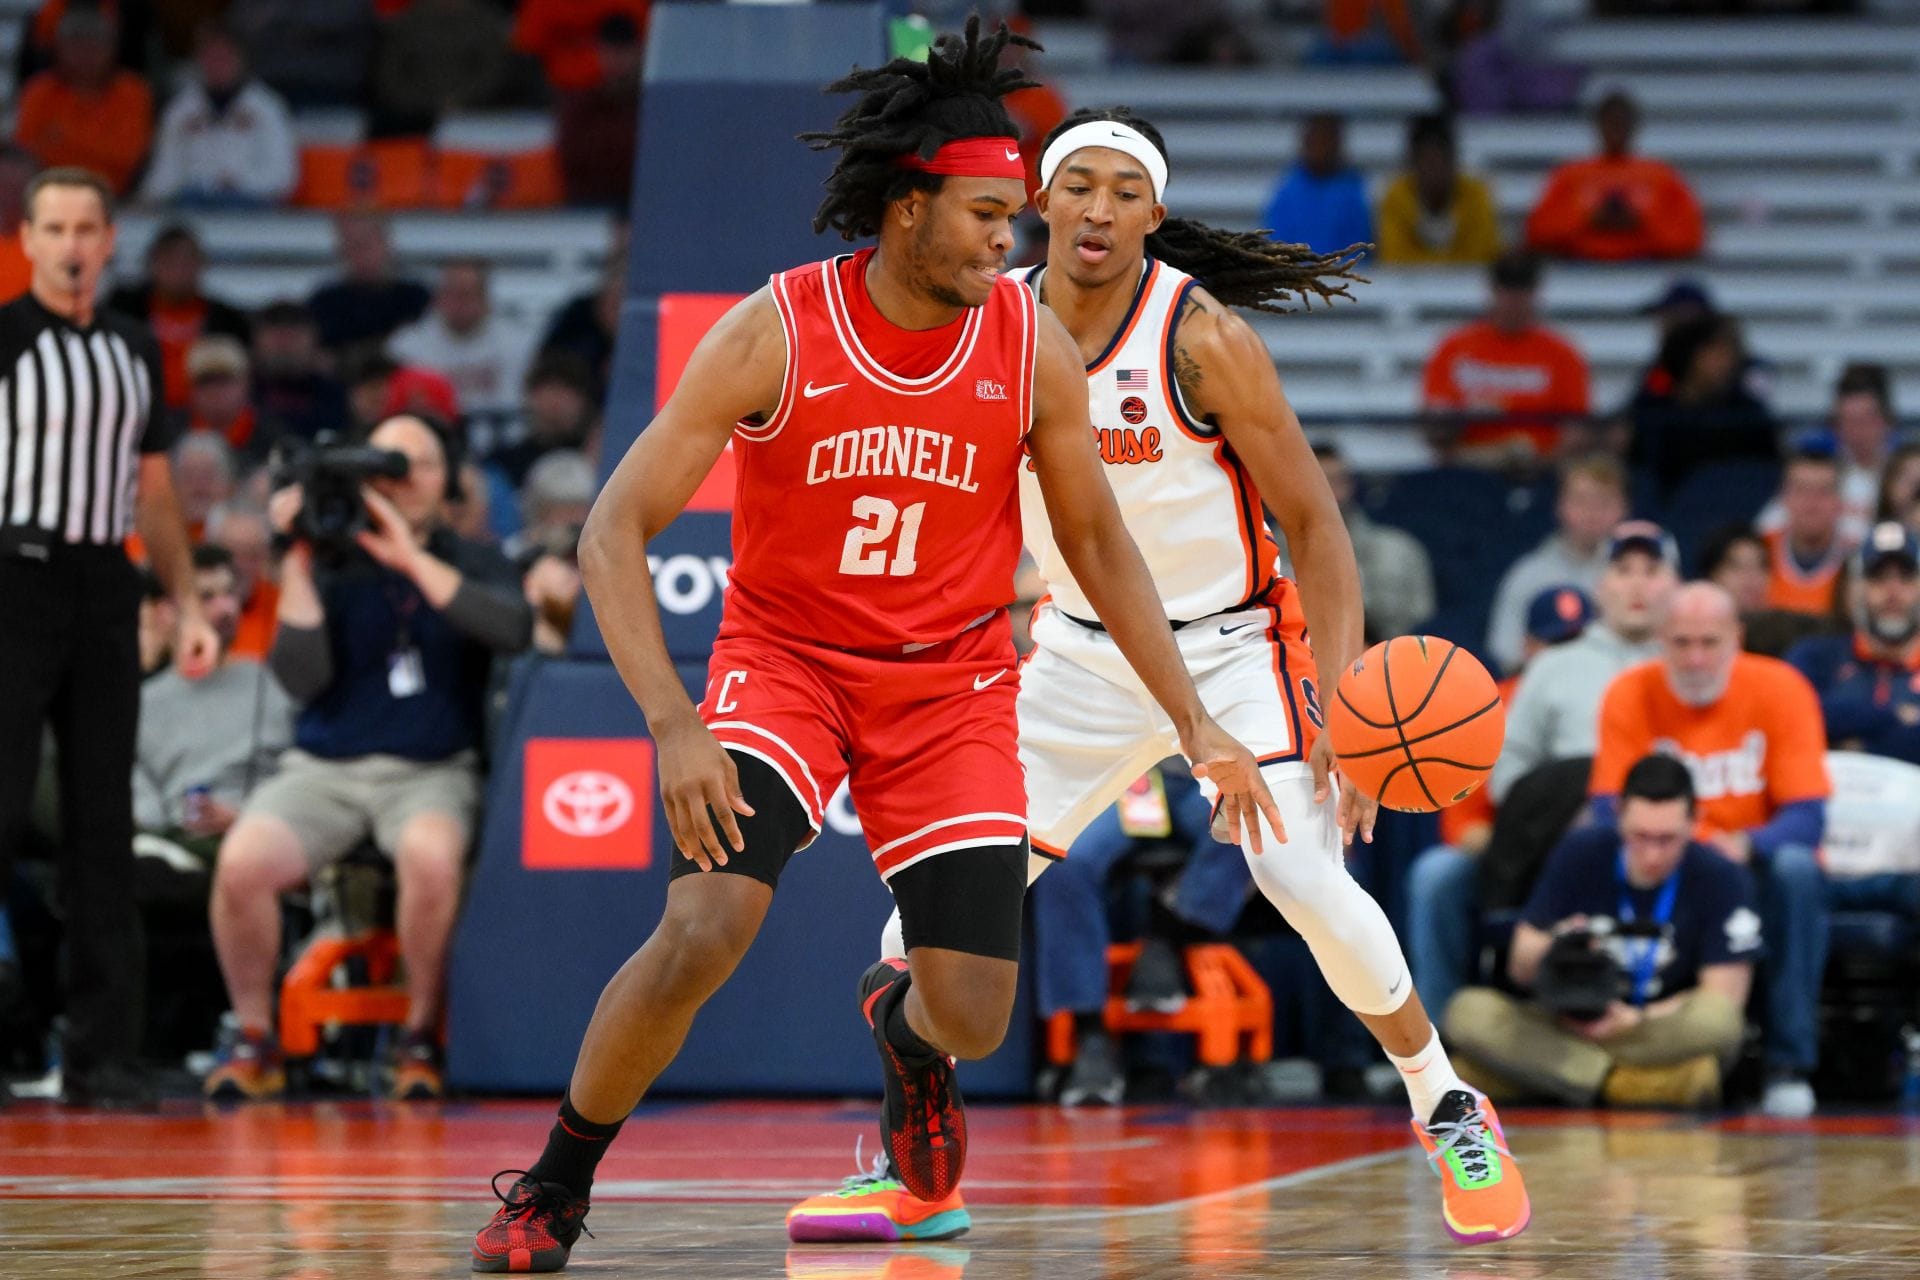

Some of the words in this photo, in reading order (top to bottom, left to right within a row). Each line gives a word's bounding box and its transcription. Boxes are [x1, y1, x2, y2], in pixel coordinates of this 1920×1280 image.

[984, 384, 1006, 395] IVY
[806, 425, 980, 493] CORNELL
[838, 495, 927, 577] 21
[715, 670, 748, 714] C
